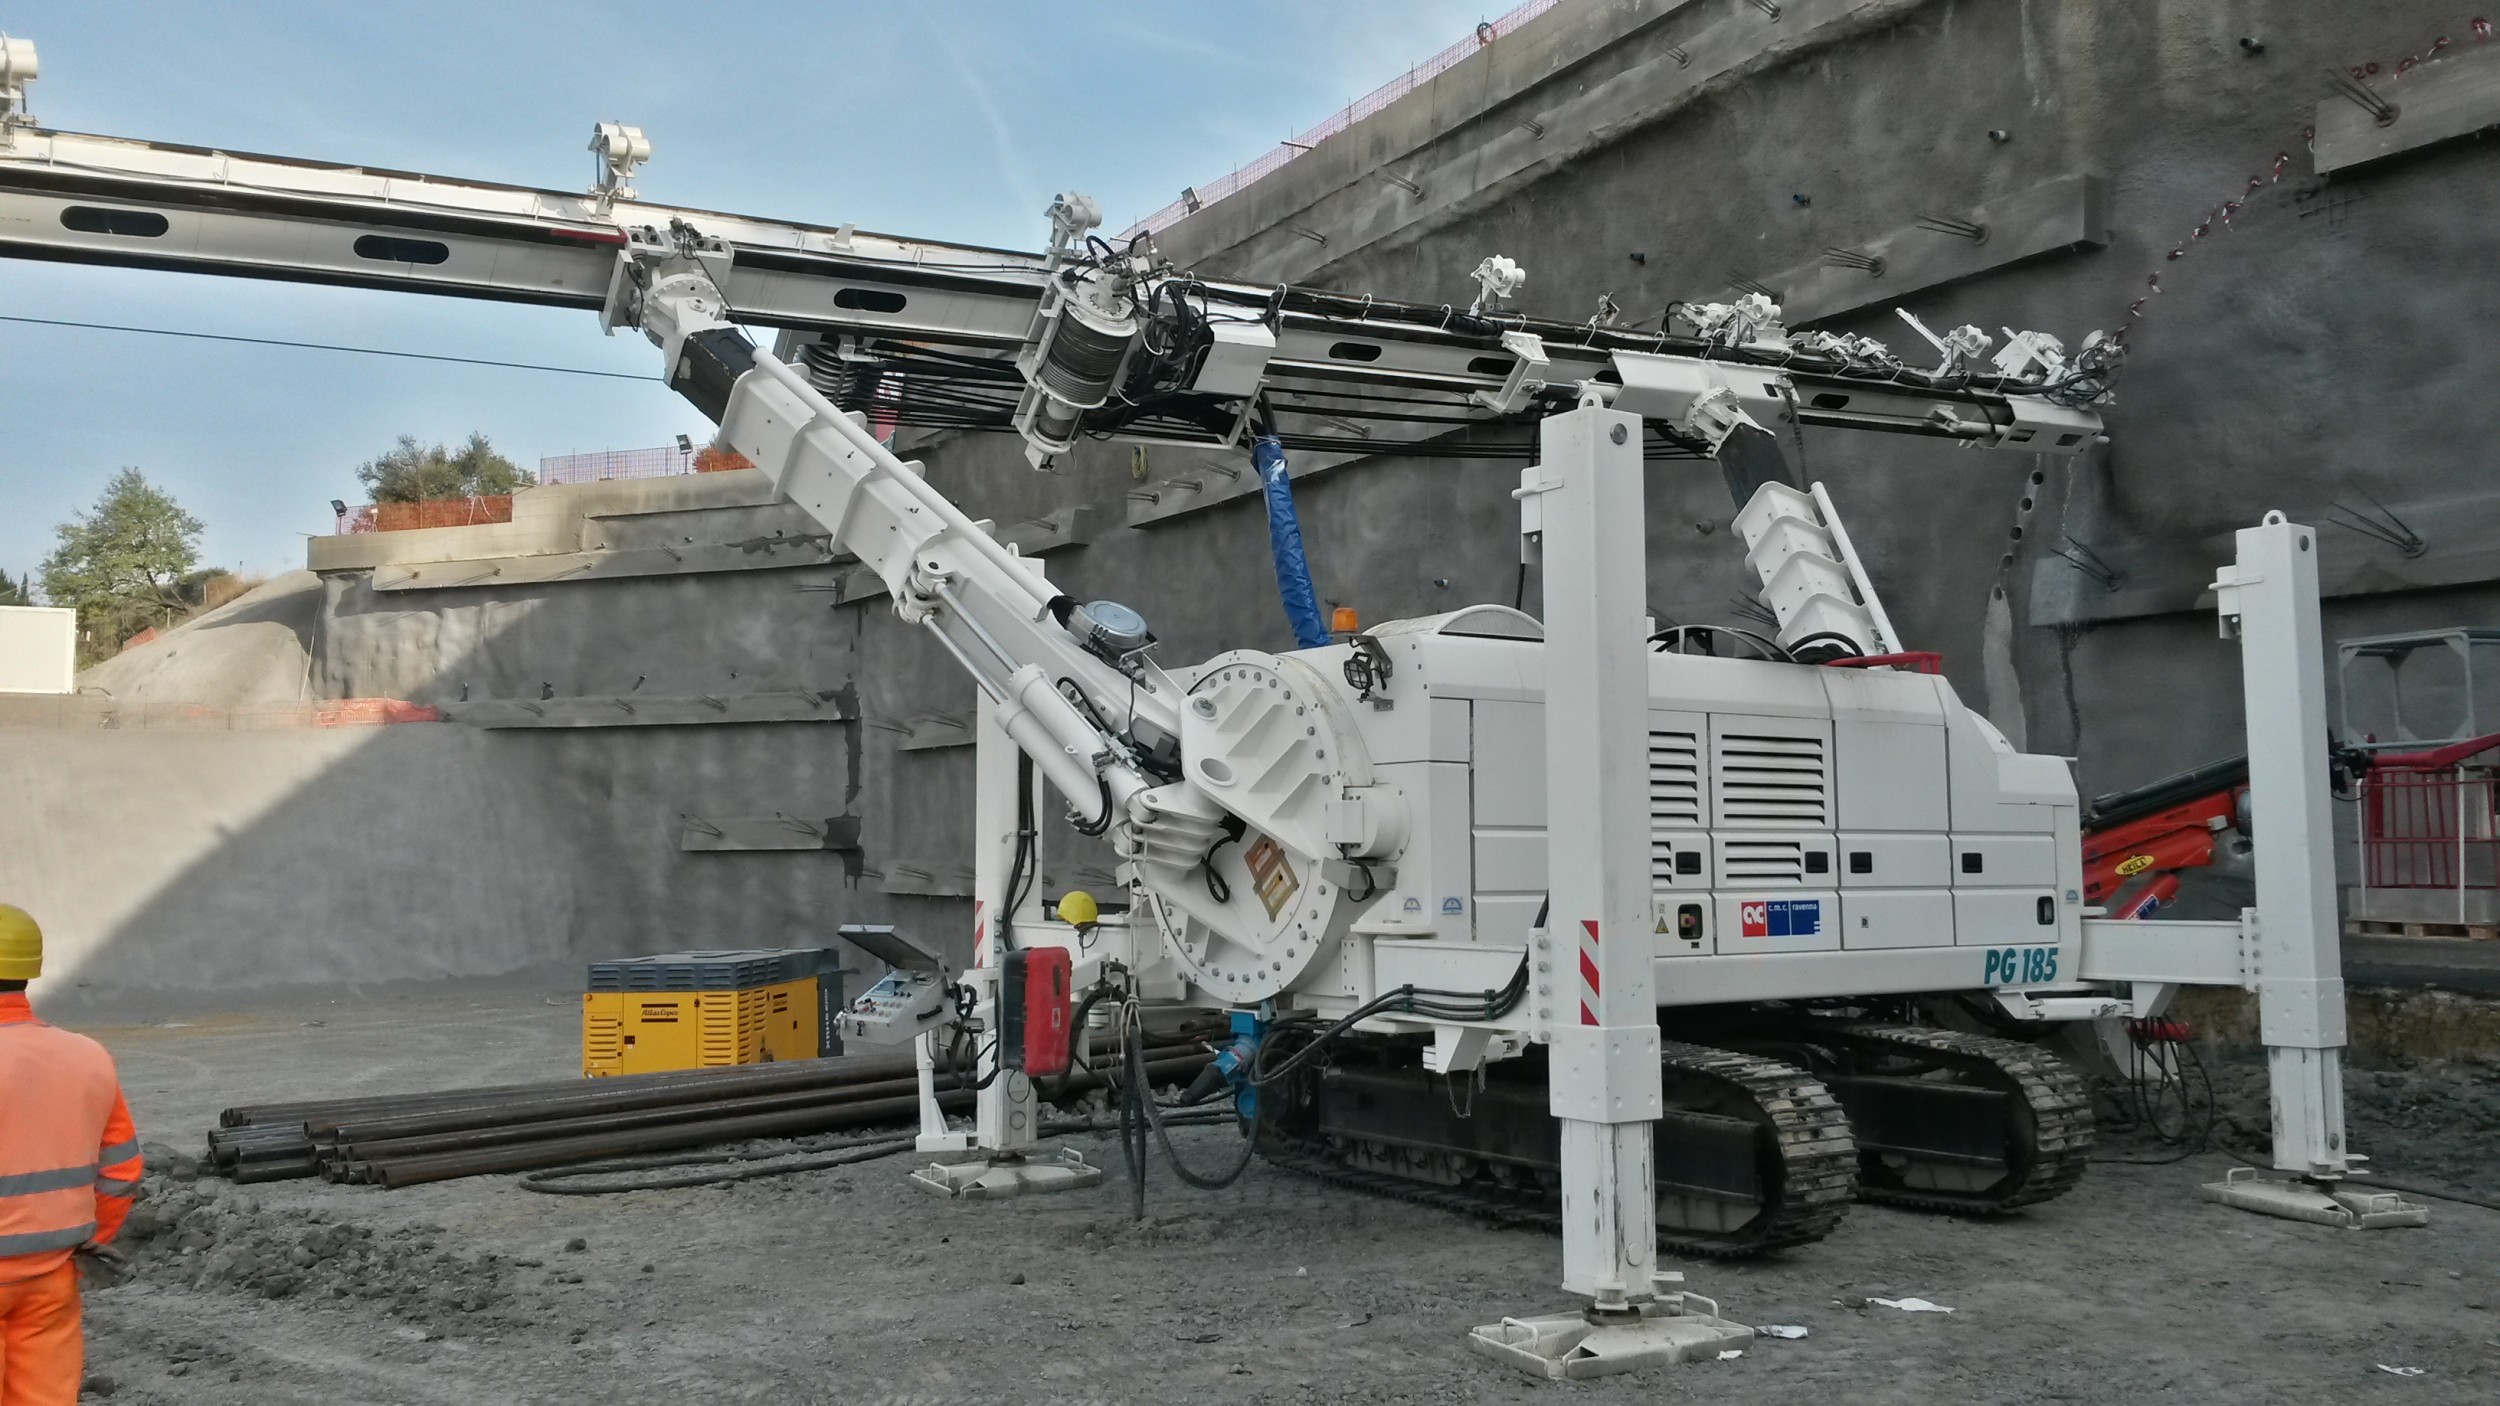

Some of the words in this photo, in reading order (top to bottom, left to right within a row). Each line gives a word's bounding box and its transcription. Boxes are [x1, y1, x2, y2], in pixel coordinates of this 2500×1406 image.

[1792, 903, 1817, 911] ravenna
[1984, 947, 2017, 985] PG
[2021, 947, 2059, 984] 185
[660, 1008, 679, 1017] Copco
